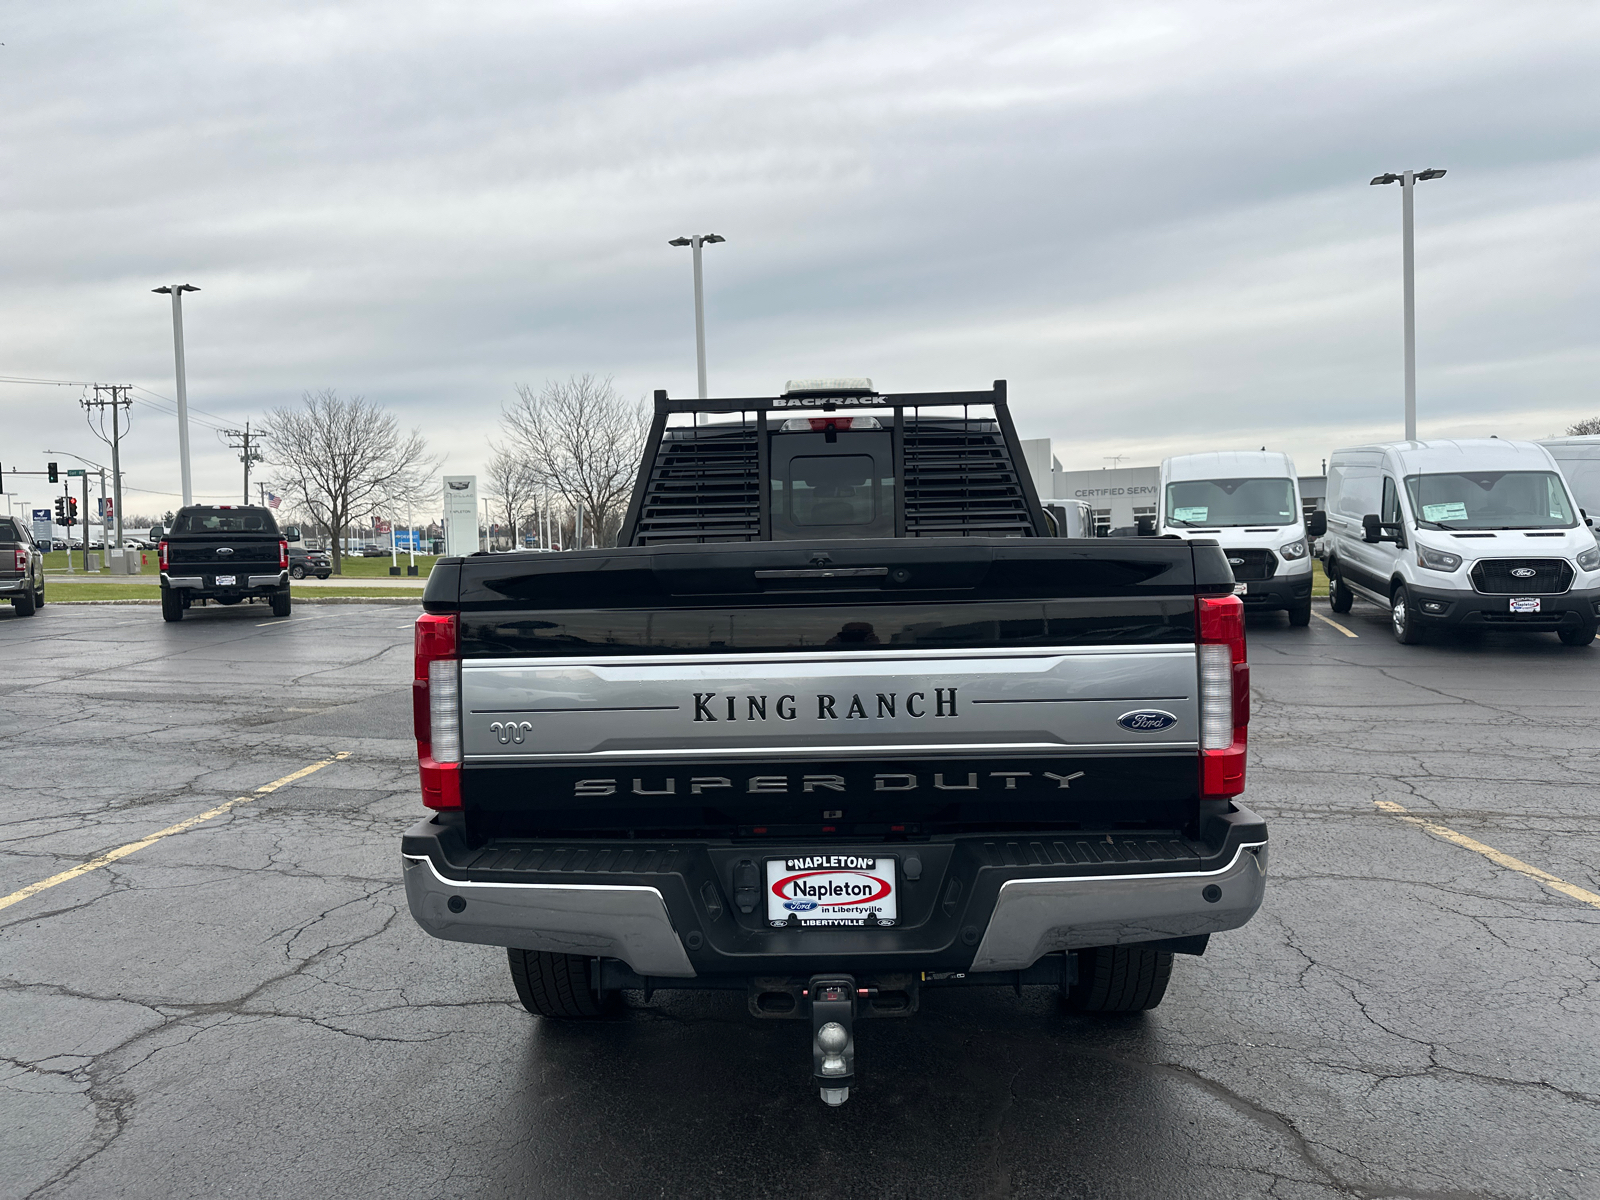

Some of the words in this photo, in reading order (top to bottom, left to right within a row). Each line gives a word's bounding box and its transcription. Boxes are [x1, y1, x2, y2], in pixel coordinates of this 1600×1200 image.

[772, 397, 886, 407] BACKRACK
[1075, 488, 1125, 497] CERTIFIED
[1127, 486, 1157, 495] SERVI
[692, 692, 797, 722] KING
[816, 687, 959, 720] RANCH
[1131, 714, 1164, 728] Ford
[574, 774, 847, 797] SUPER
[873, 770, 1086, 793] DUTY
[794, 856, 867, 869] NAPLETON
[793, 880, 873, 900] Napleton
[832, 906, 883, 914] Libertyville
